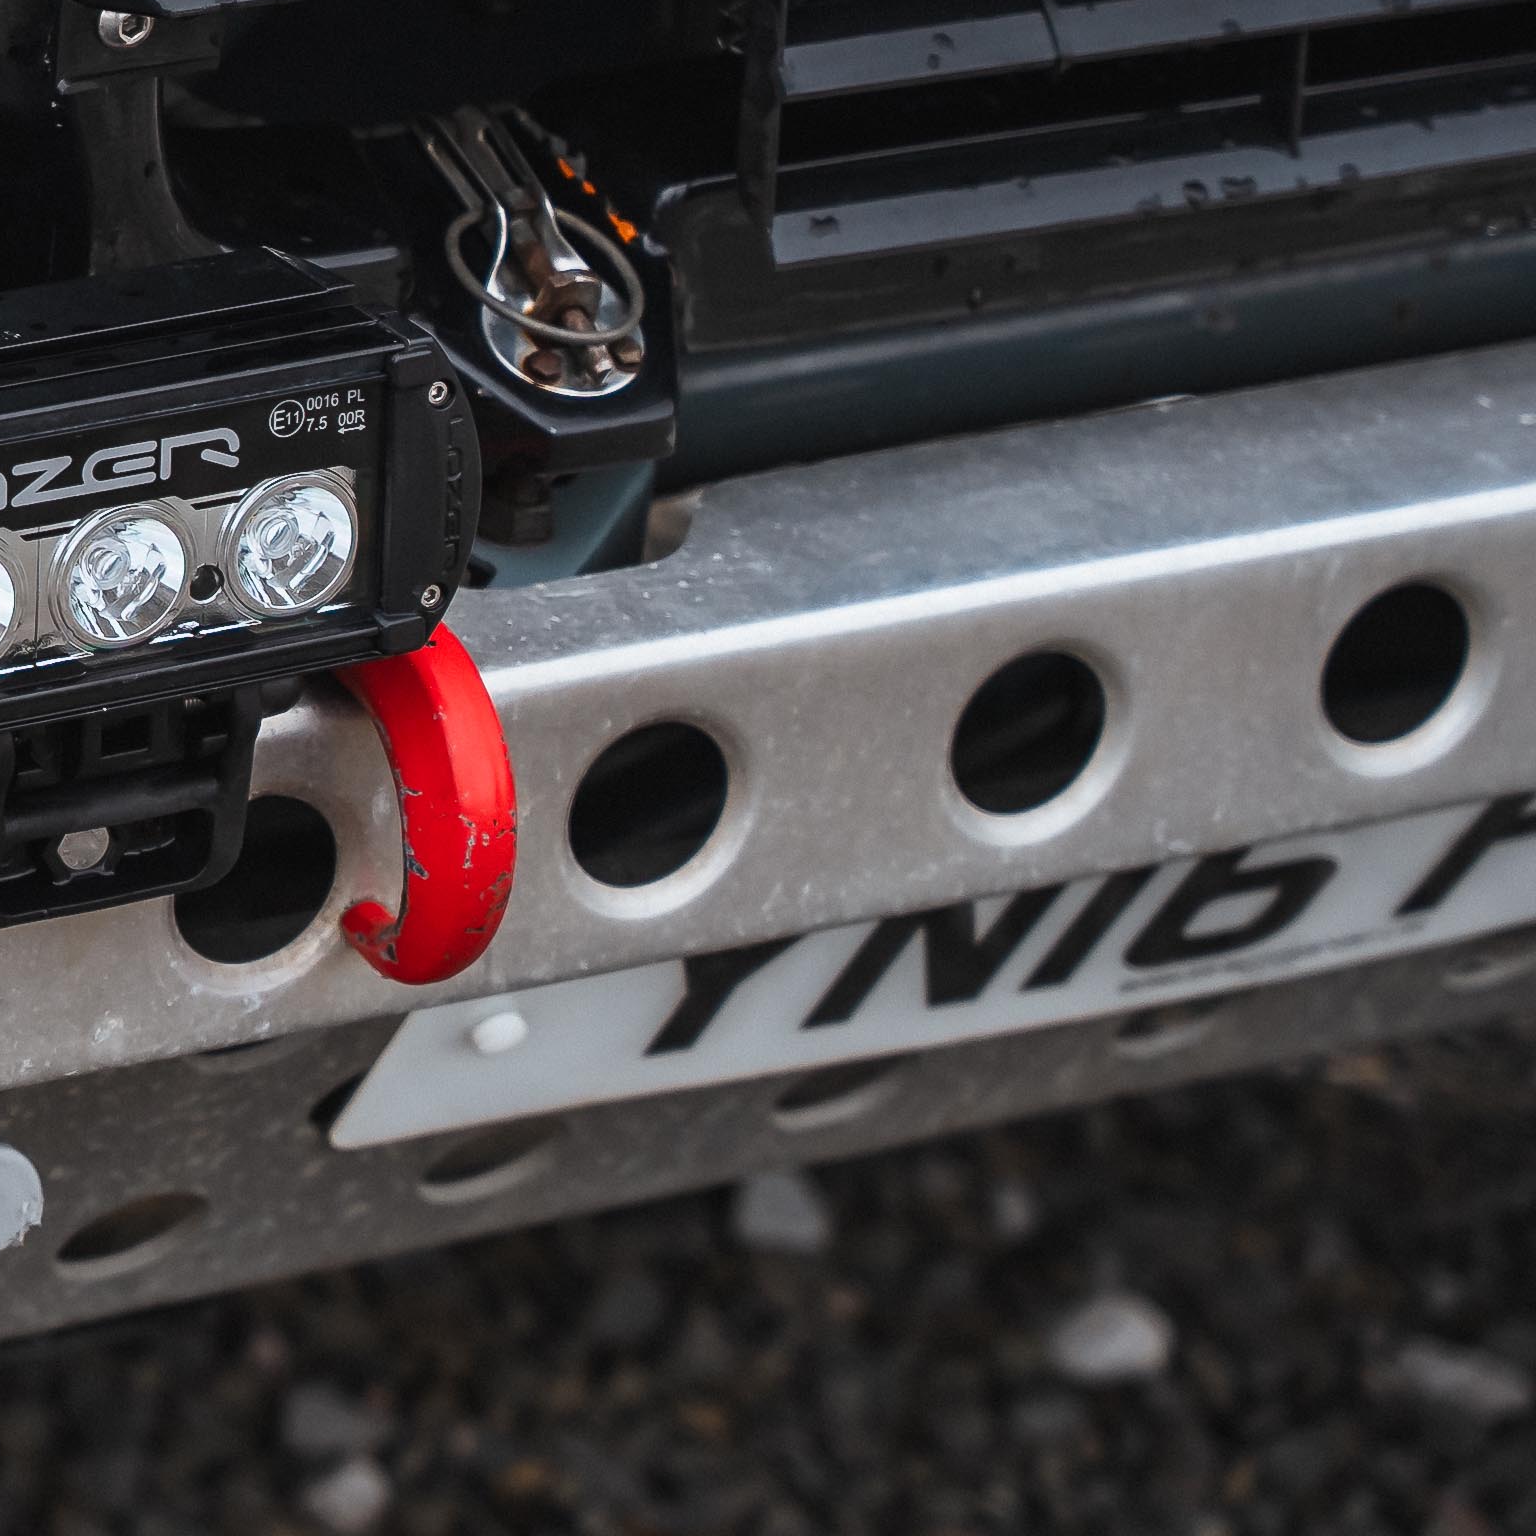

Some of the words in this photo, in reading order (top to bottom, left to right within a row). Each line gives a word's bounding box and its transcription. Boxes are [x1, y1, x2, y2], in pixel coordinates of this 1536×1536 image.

[306, 392, 339, 410] 0016
[347, 389, 366, 404] PL
[273, 409, 301, 431] E11
[306, 415, 328, 433] 7.5
[337, 409, 365, 426] 00R
